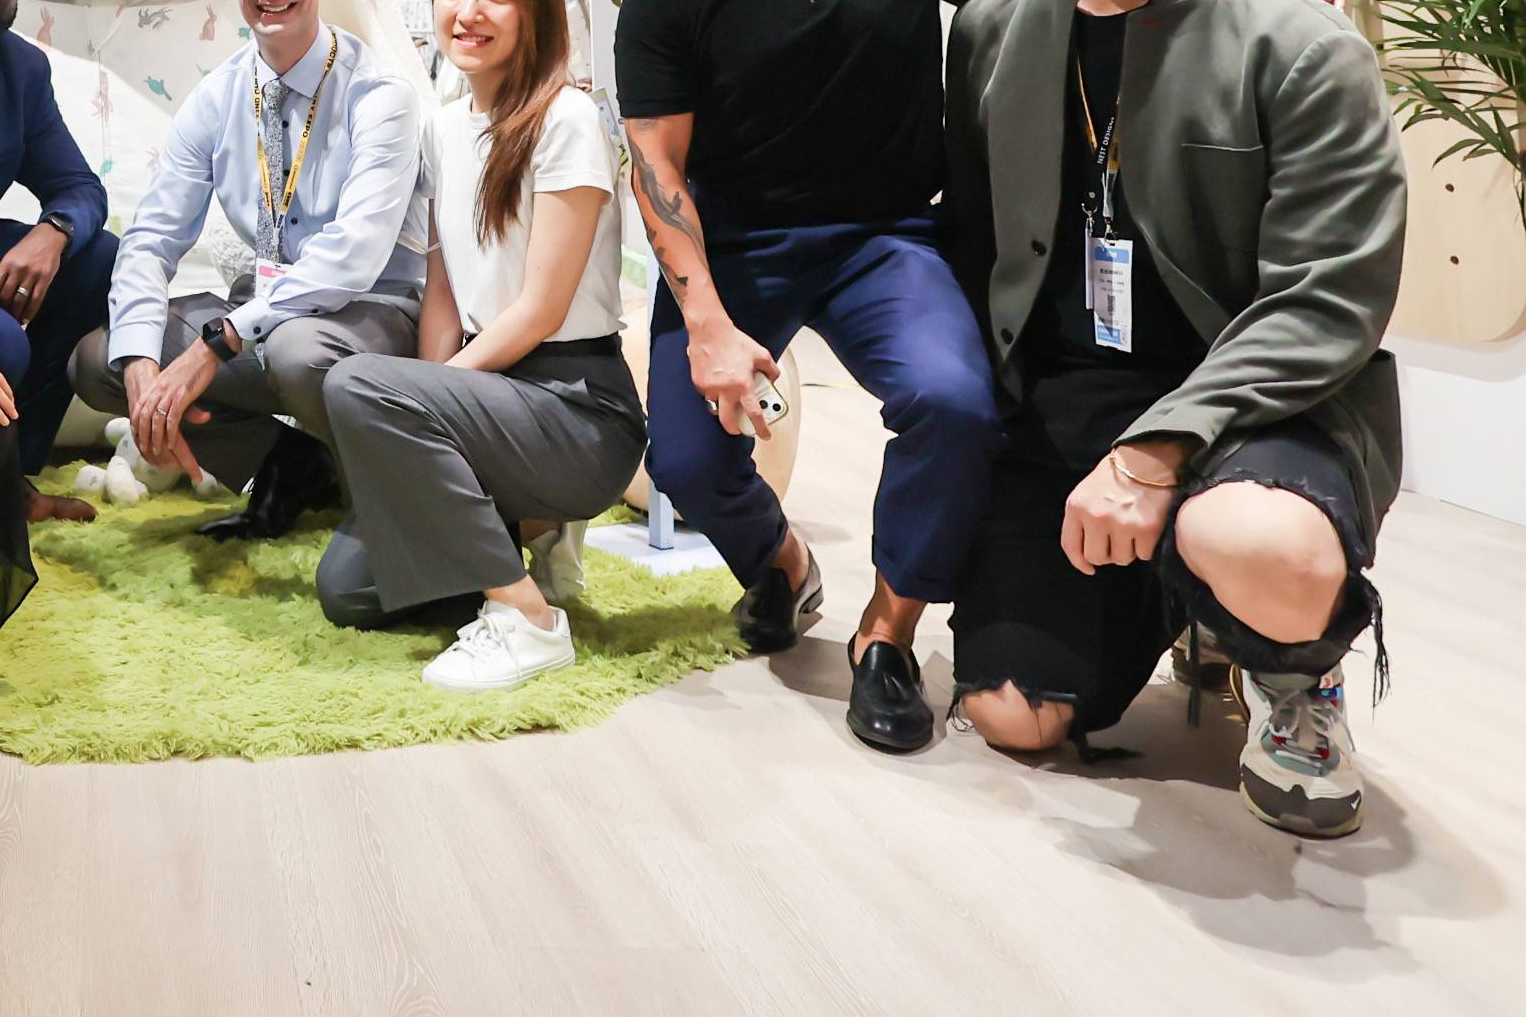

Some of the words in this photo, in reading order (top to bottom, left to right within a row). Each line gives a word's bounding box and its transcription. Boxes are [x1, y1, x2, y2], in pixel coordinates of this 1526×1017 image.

[302, 114, 313, 139] EXPO
[1097, 147, 1106, 165] NEST
[1102, 116, 1115, 146] DESIGNS
